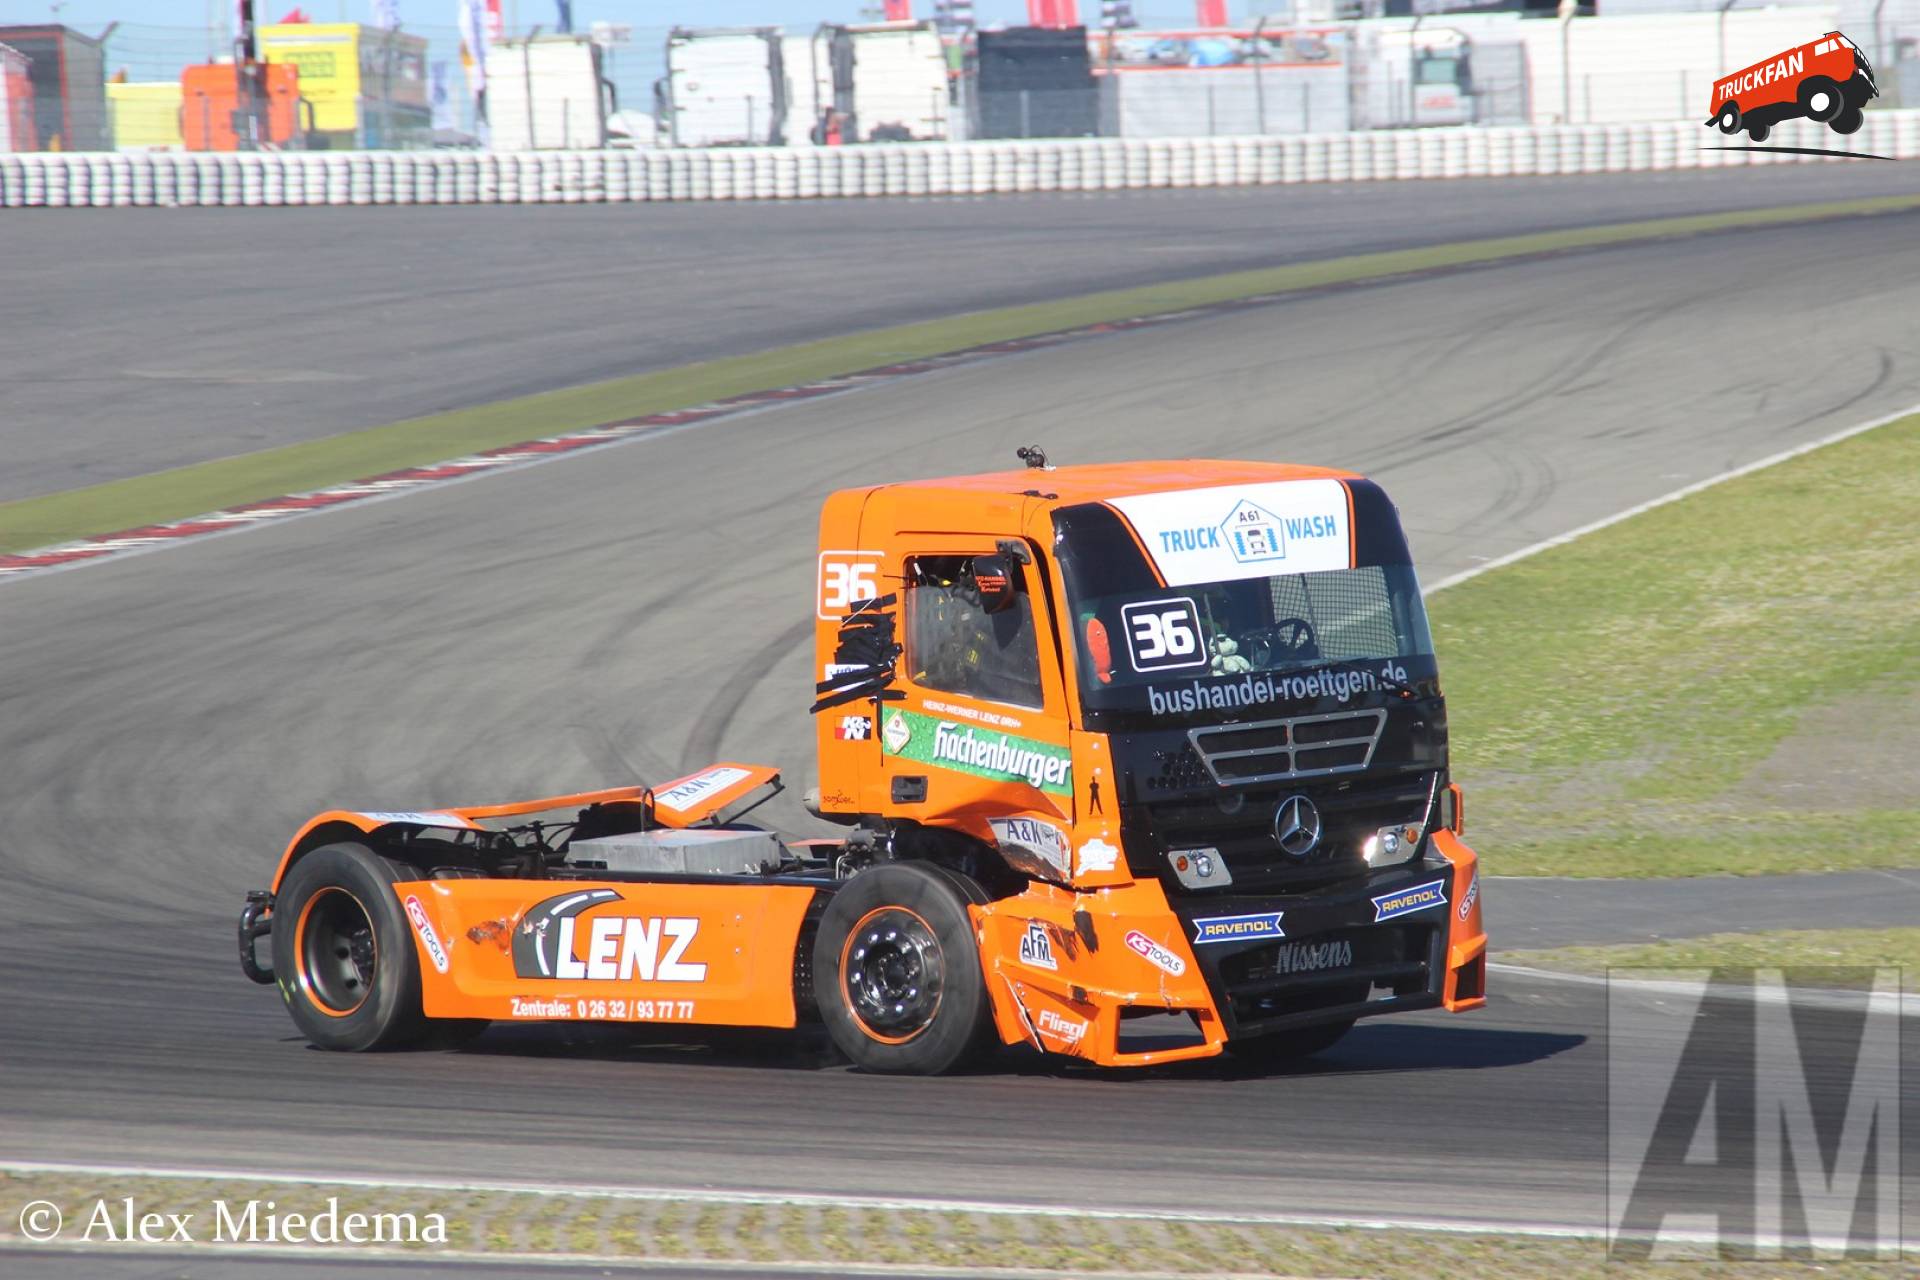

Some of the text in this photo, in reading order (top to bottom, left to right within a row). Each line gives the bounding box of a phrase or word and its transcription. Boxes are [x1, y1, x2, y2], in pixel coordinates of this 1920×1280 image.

[1159, 515, 1337, 553] TRUCK WASH
[825, 563, 876, 607] 36
[1132, 610, 1195, 660] 36
[1148, 660, 1407, 716] bushandel-roettgen.de
[979, 711, 1001, 725] LENZ
[933, 721, 1072, 788] Hachenburger
[1007, 820, 1042, 846] A&K
[1382, 888, 1436, 913] RAVENOL
[409, 900, 446, 969] KS TOOLS
[1205, 921, 1272, 936] RAVENOL
[555, 916, 708, 983] LENZ
[1128, 933, 1181, 973] KS TOOLS
[1276, 939, 1352, 974] Nissens
[512, 999, 571, 1018] Zentrale:
[577, 1000, 587, 1018] 0
[589, 1000, 606, 1018] 26
[609, 1000, 626, 1018] 32
[637, 1001, 654, 1019] 93
[656, 1001, 674, 1019] 77
[676, 1001, 694, 1019] 77
[1039, 1010, 1088, 1043] Fliegl
